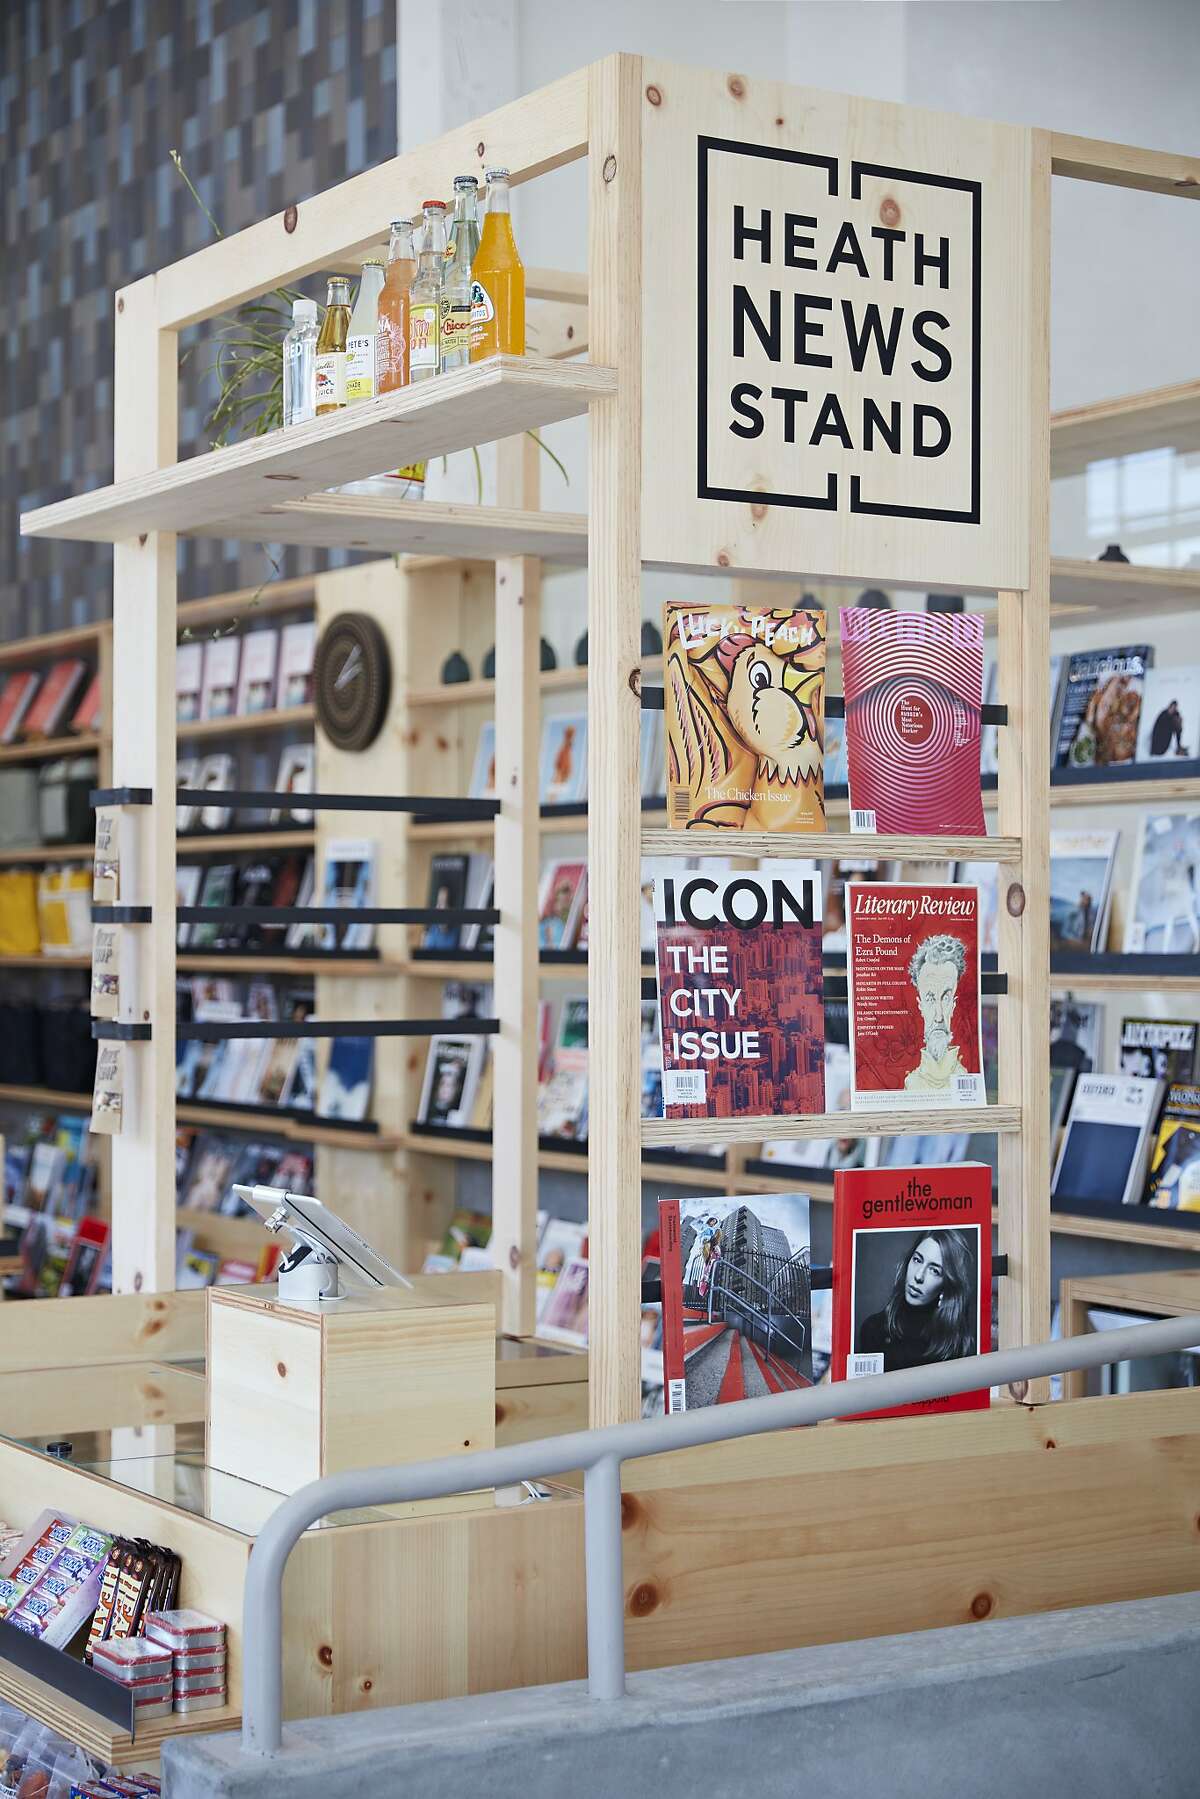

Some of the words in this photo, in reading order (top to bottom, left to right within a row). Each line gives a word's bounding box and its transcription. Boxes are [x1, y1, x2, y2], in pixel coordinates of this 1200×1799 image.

[733, 204, 950, 290] HEATH
[442, 319, 470, 336] Chico
[732, 284, 952, 383] NEWS
[728, 382, 952, 458] STAND
[705, 787, 726, 800] The
[727, 787, 767, 801] Chicken
[767, 790, 792, 802] Issue
[663, 878, 814, 930] ICON
[854, 894, 919, 921] Literary
[919, 895, 976, 915] Review
[855, 934, 872, 944] The
[873, 934, 903, 944] Demons
[904, 934, 912, 944] of
[855, 947, 874, 956] Ezra
[875, 947, 898, 956] Pound
[666, 945, 729, 974] THE
[670, 988, 742, 1017] CITY
[673, 1031, 761, 1061] ISSUE
[907, 1176, 932, 1198] the
[862, 1190, 973, 1219] gentlewoman
